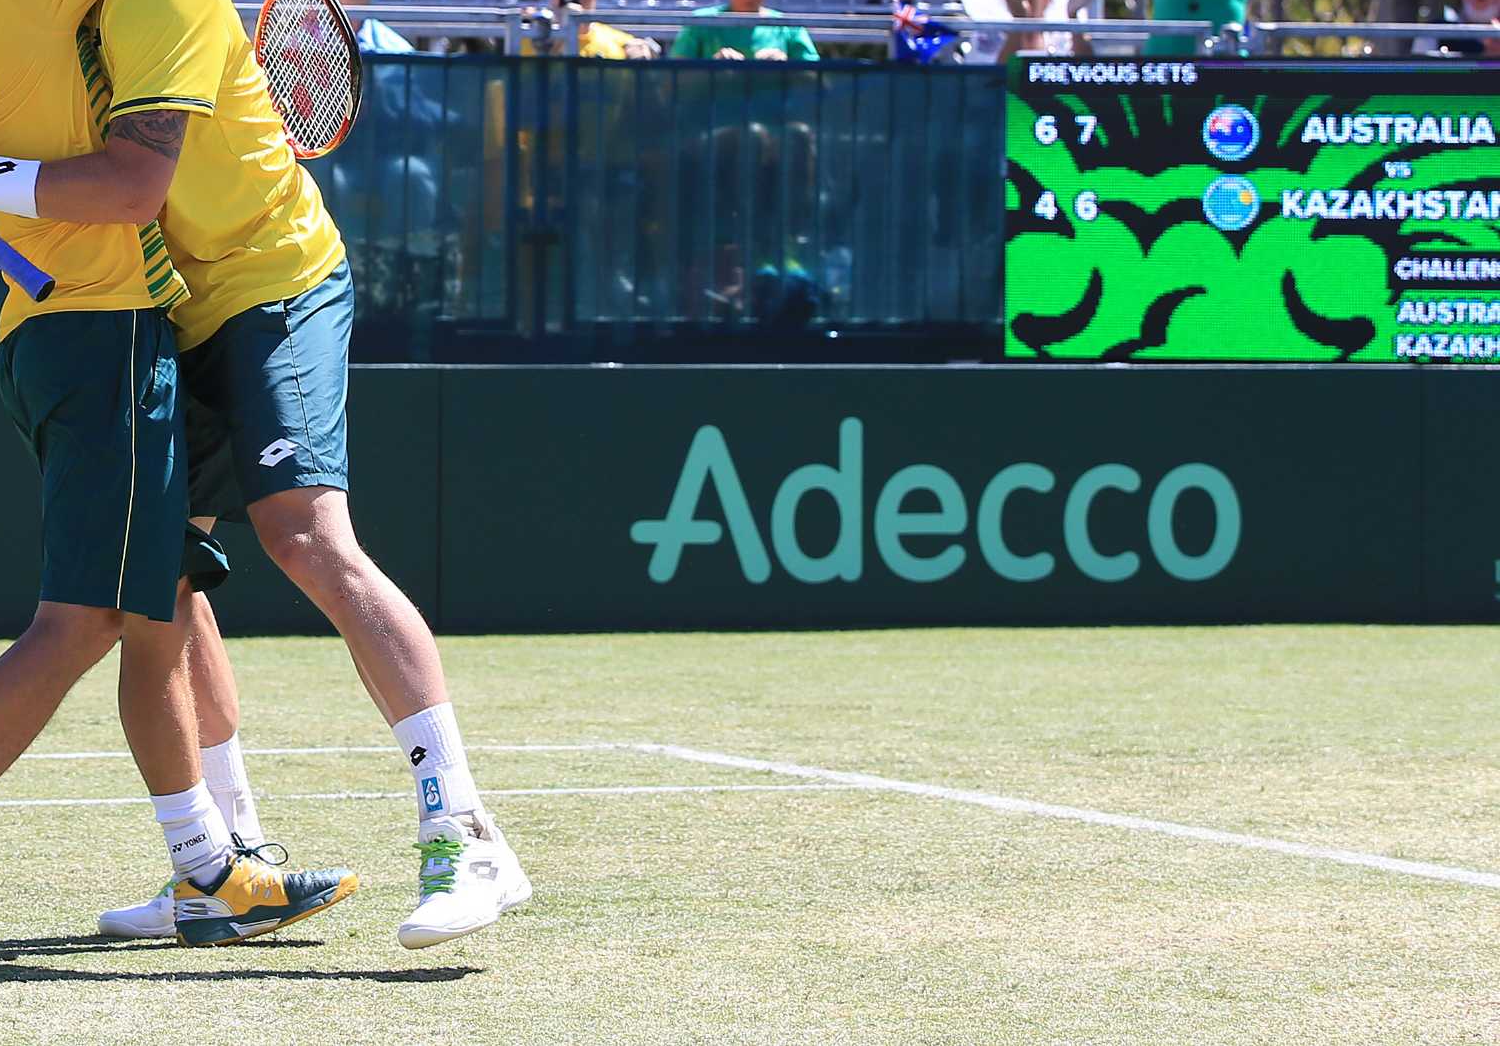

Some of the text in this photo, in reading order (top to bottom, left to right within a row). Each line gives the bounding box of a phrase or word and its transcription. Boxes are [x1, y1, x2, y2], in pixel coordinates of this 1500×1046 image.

[1028, 63, 1198, 86] PREVIOUS SETS
[1035, 115, 1098, 145] 6 7
[1301, 114, 1496, 144] AUSTRALIA
[1034, 190, 1098, 221] 4 6
[630, 417, 1242, 584] Adecco
[183, 833, 207, 848] YONEX
